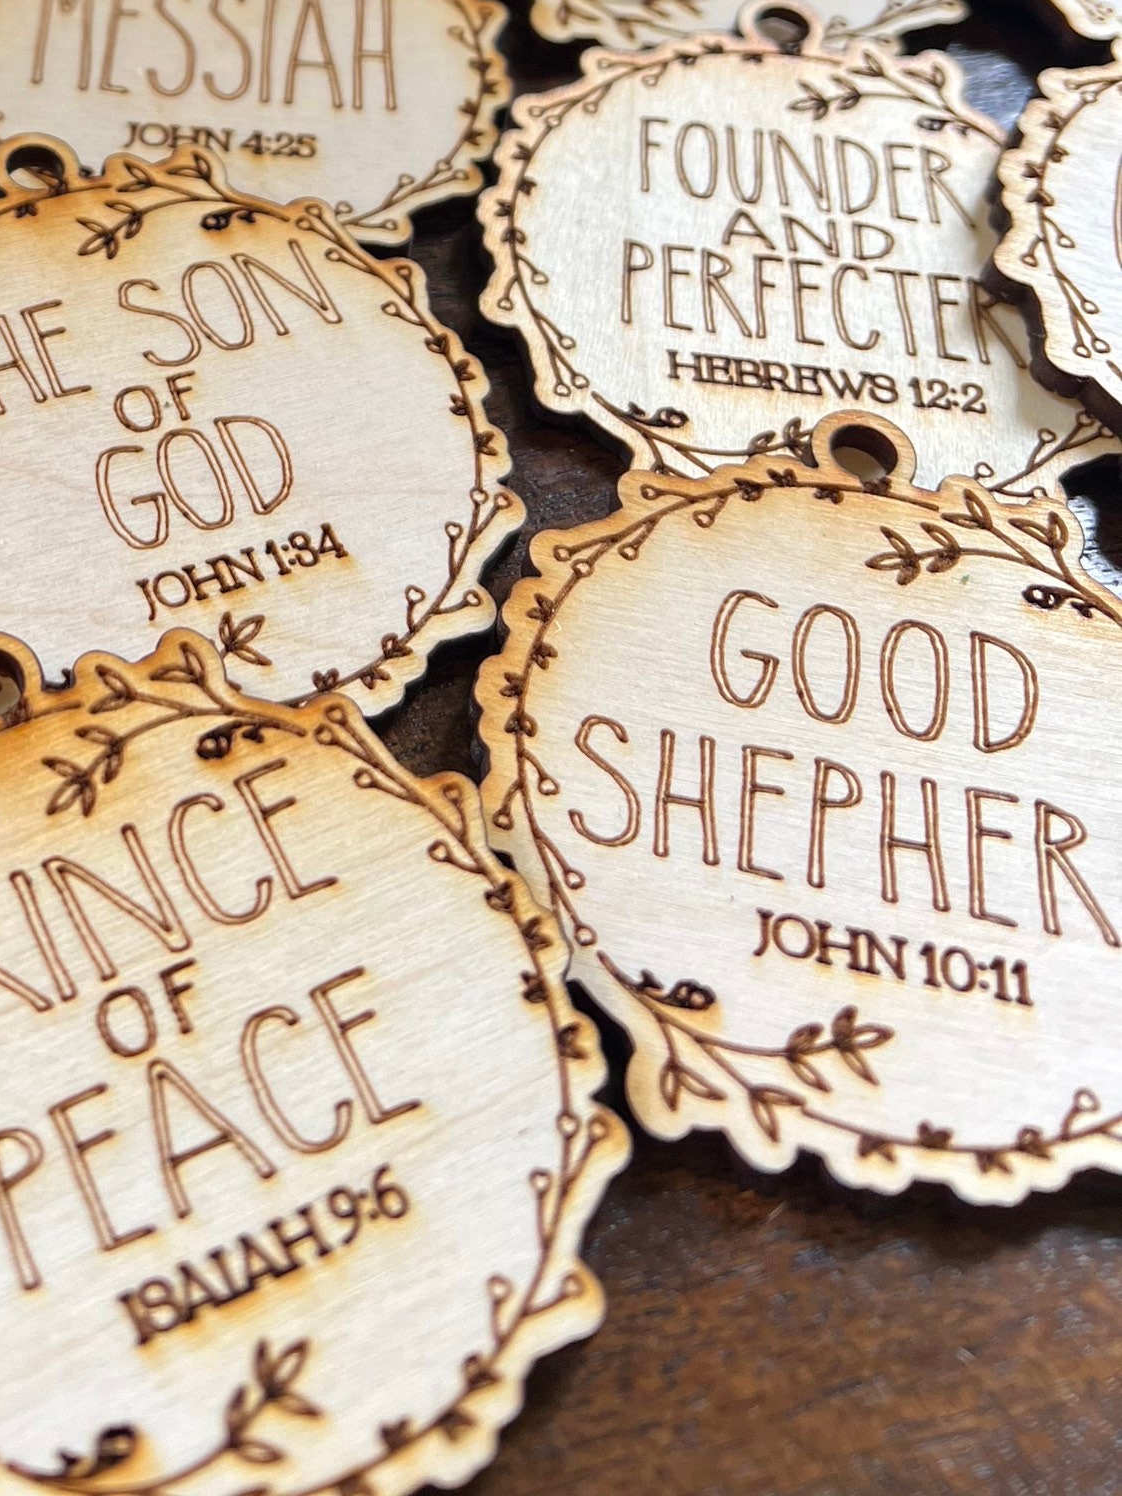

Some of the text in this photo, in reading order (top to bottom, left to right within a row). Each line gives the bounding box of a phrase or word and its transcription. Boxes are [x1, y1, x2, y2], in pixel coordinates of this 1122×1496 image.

[124, 121, 317, 159] JOHN 4:25
[639, 115, 977, 228] FOUNDER
[722, 209, 895, 261] AND
[118, 238, 342, 367] SON
[113, 370, 197, 432] OF
[667, 350, 987, 416] HEBREWS 12:2
[96, 415, 292, 549] GOD
[135, 522, 350, 621] JOHN 1:34
[710, 588, 1039, 753] GOOD
[754, 909, 1033, 1007] JOHN 10:11
[95, 958, 196, 1059] OF
[118, 1162, 411, 1346] ISAIAH 9:6
